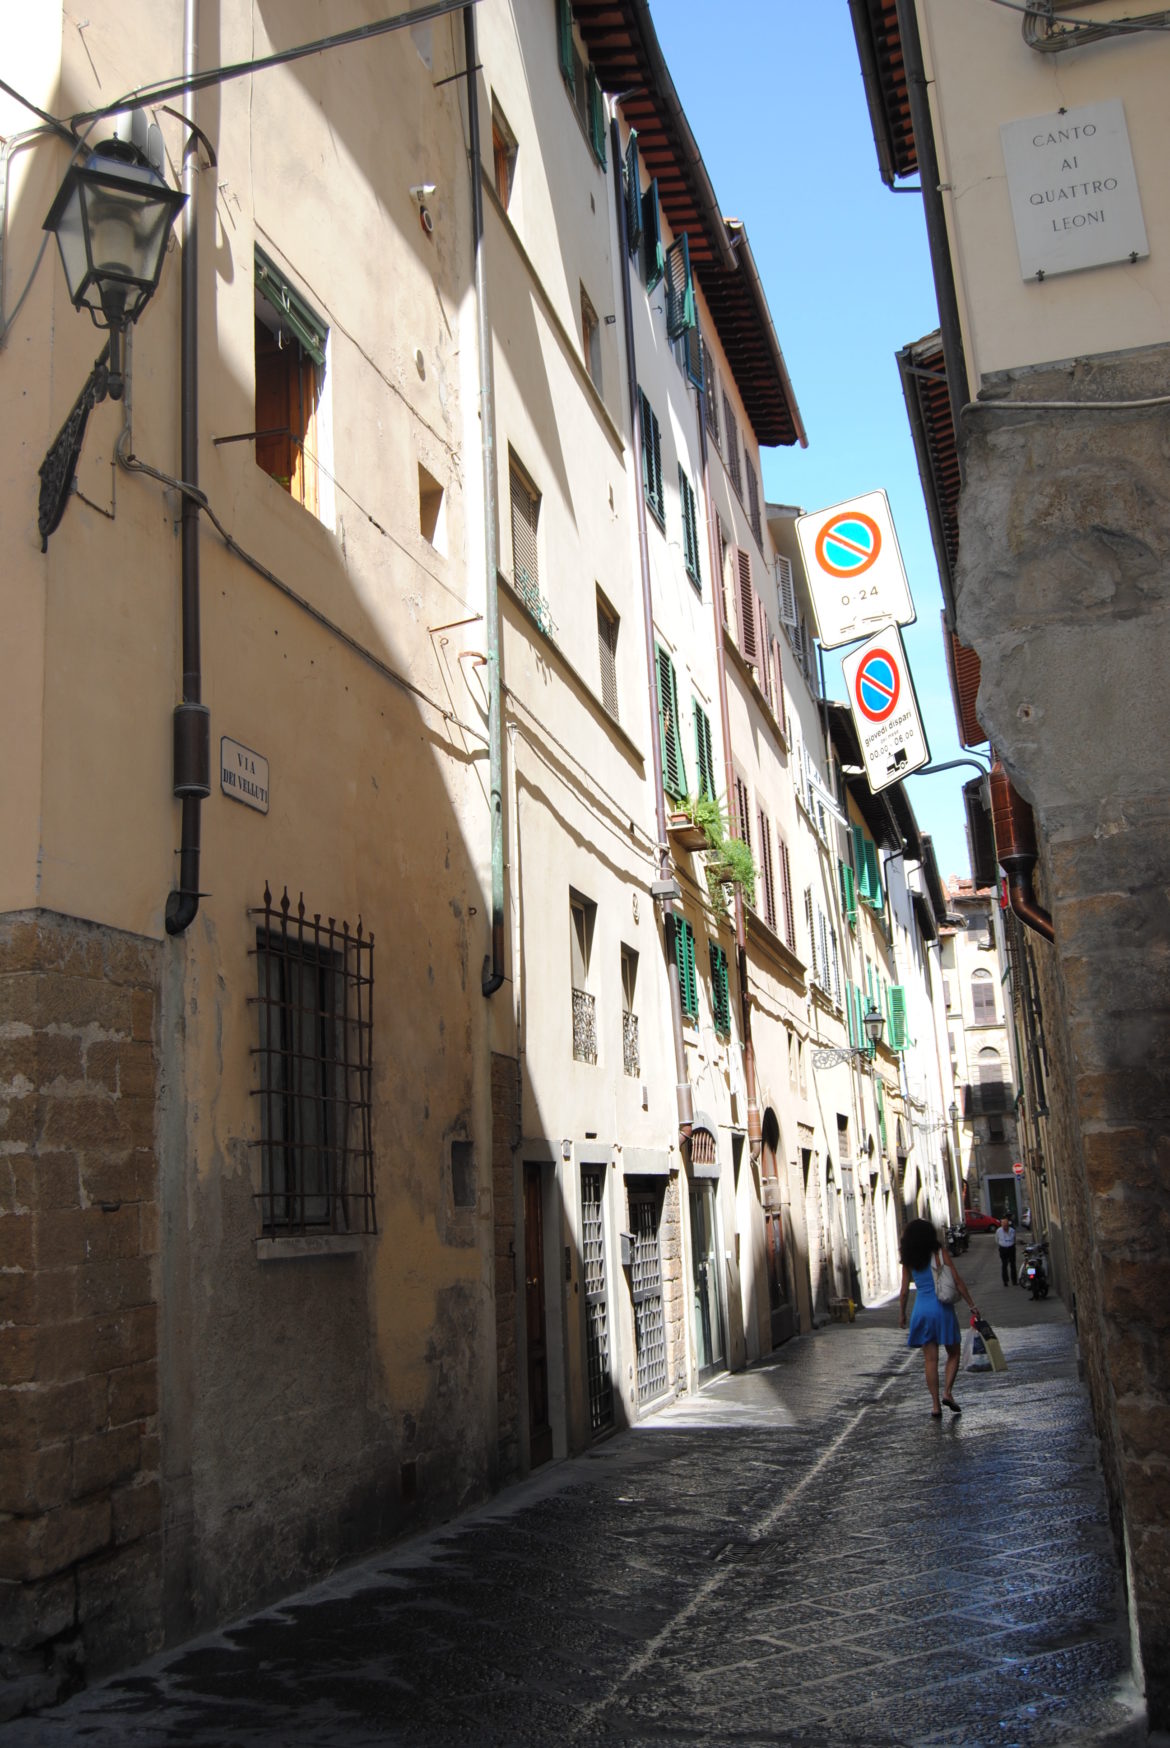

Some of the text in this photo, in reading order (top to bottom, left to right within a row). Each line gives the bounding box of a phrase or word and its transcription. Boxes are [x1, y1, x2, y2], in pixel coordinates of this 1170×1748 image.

[1032, 124, 1097, 148] CANTO
[1061, 156, 1079, 172] AI
[1029, 178, 1119, 206] QUATTRO
[1052, 210, 1105, 232] LEONI
[888, 711, 912, 730] dispari
[237, 753, 255, 775] VIA
[223, 768, 268, 804] DEI VELLUTI
